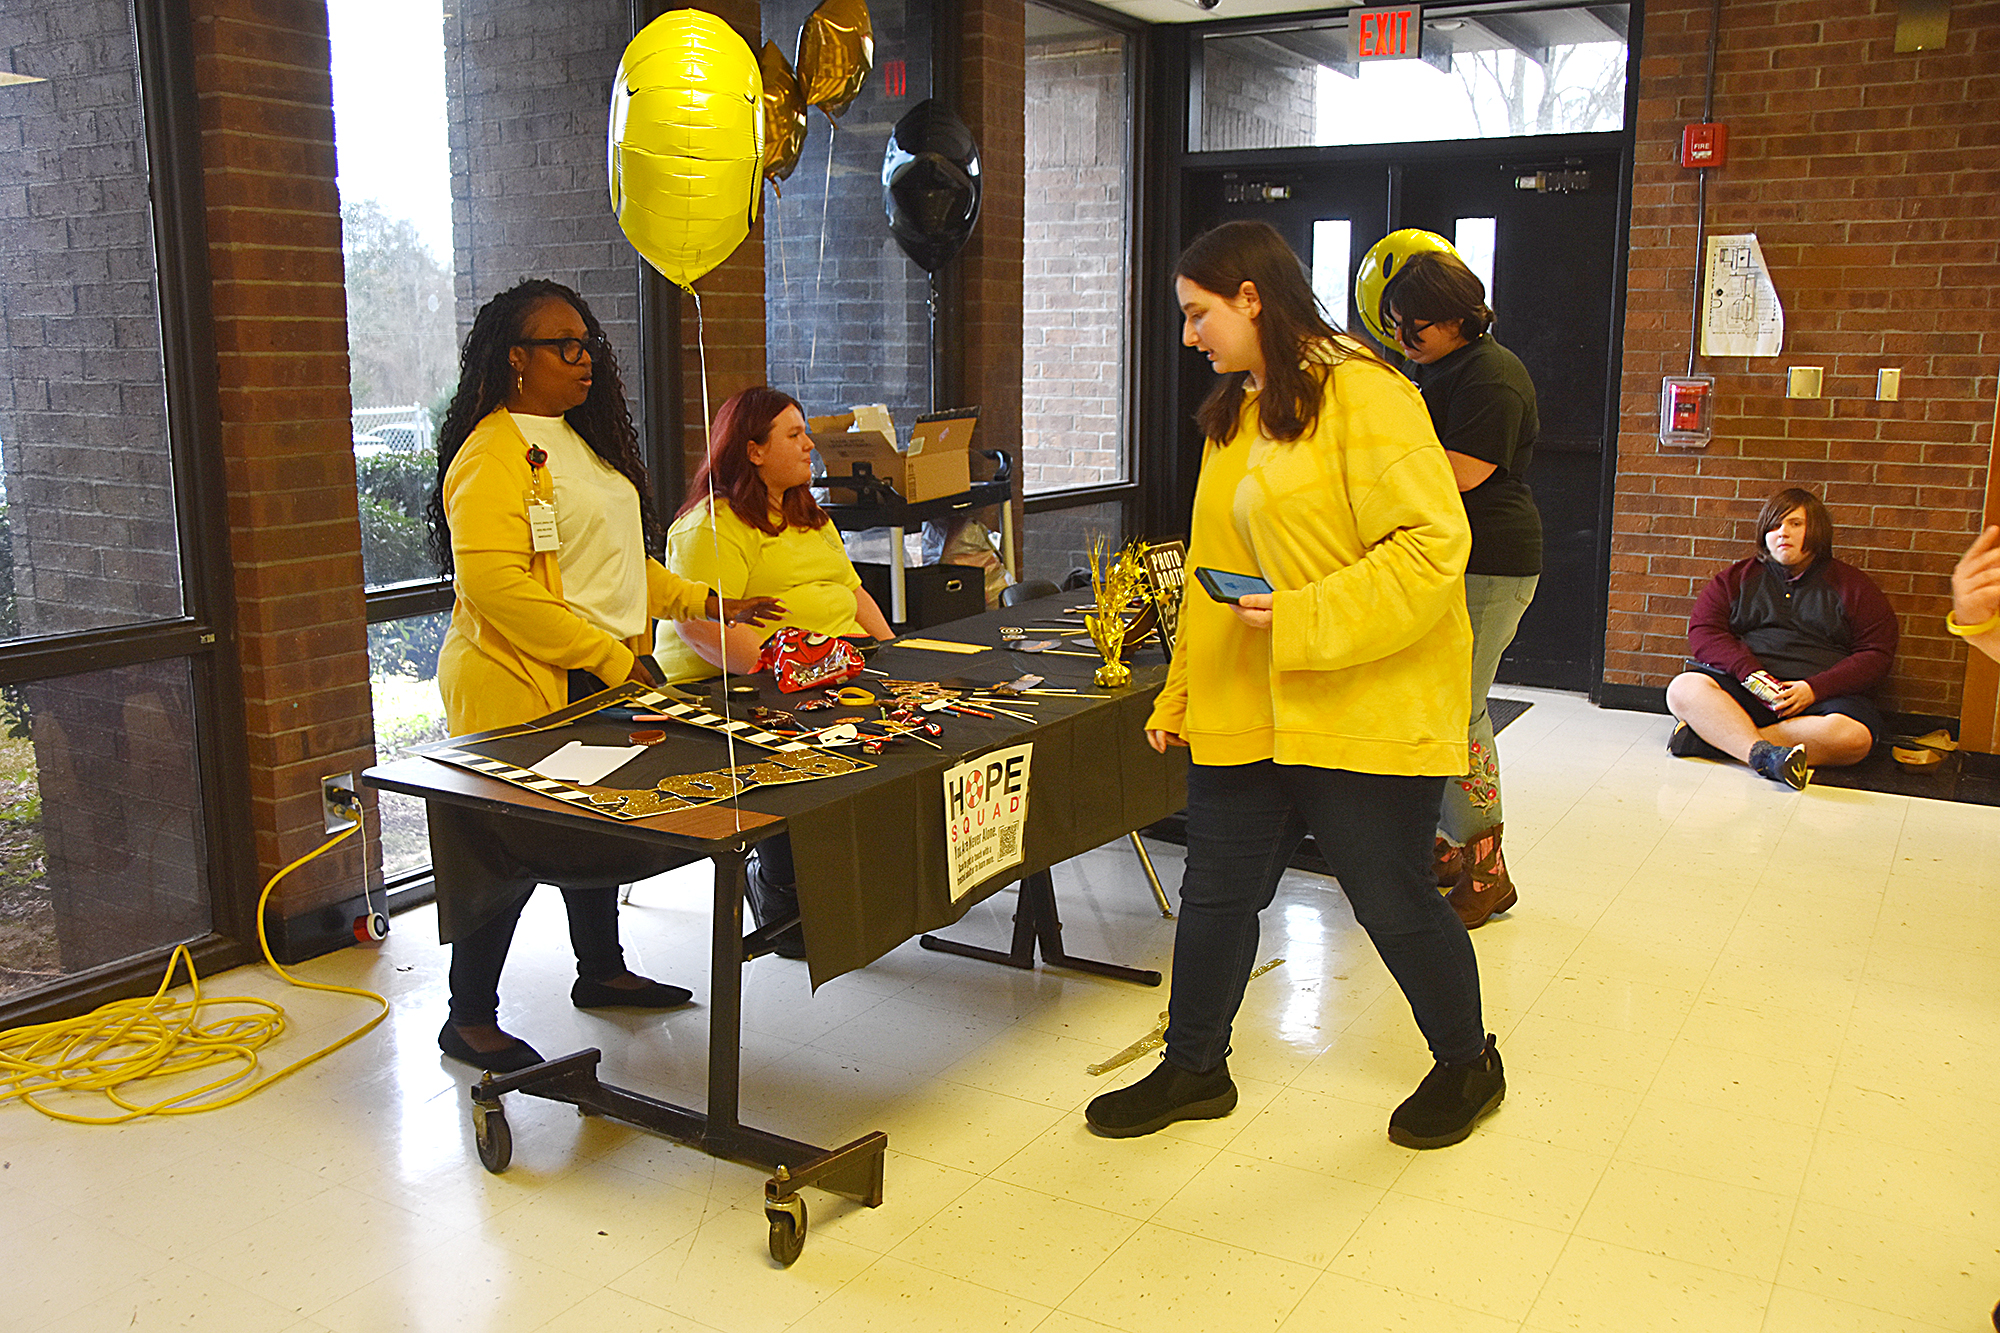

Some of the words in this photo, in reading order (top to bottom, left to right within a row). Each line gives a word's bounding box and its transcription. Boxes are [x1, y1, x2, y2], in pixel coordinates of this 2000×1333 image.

[1359, 11, 1412, 57] EXIT
[1150, 549, 1182, 572] PHOTO
[589, 749, 856, 818] 2025
[949, 755, 1025, 821] HOPE
[951, 795, 1021, 843] SQUAD
[969, 834, 982, 850] Never
[982, 826, 998, 843] Alone.
